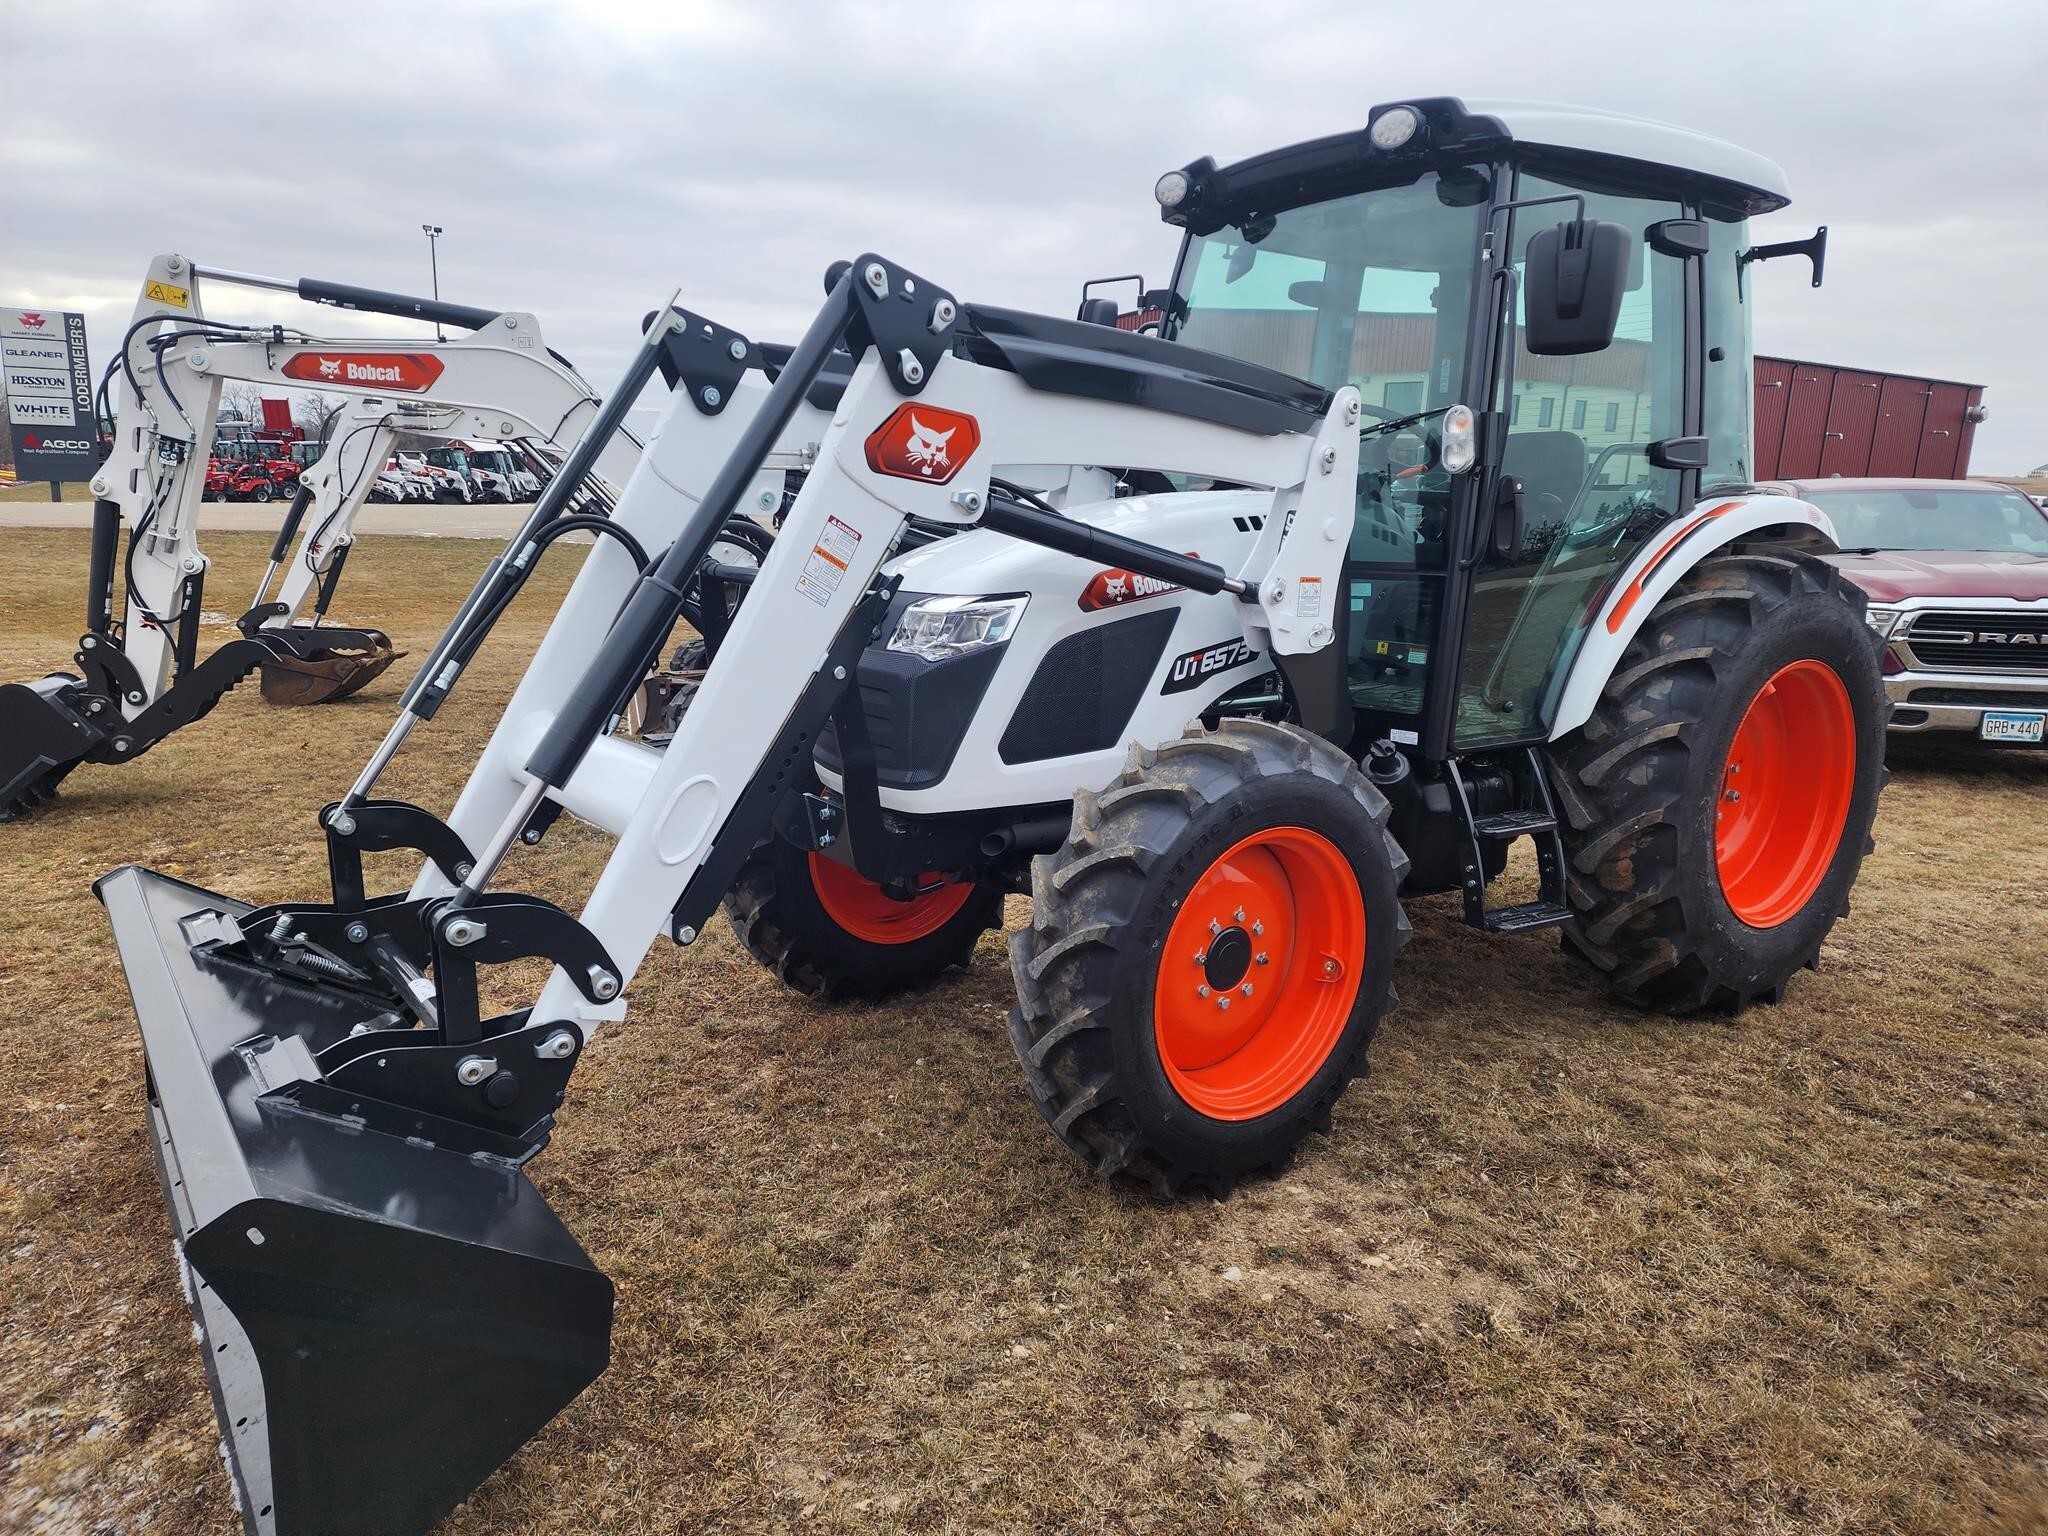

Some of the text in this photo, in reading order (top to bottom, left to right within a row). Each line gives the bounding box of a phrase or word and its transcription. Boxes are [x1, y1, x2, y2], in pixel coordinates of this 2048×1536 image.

[5, 349, 64, 359] GLEANER
[69, 318, 90, 411] LODERMEIER'S
[346, 363, 401, 382] Bobcat
[11, 375, 66, 387] HESSTON
[14, 404, 70, 415] WHITE
[42, 439, 90, 449] AGCO
[35, 448, 64, 456] Agriculture
[837, 521, 859, 540] DANGER
[1986, 720, 2009, 734] GRB
[2017, 722, 2040, 736] 440
